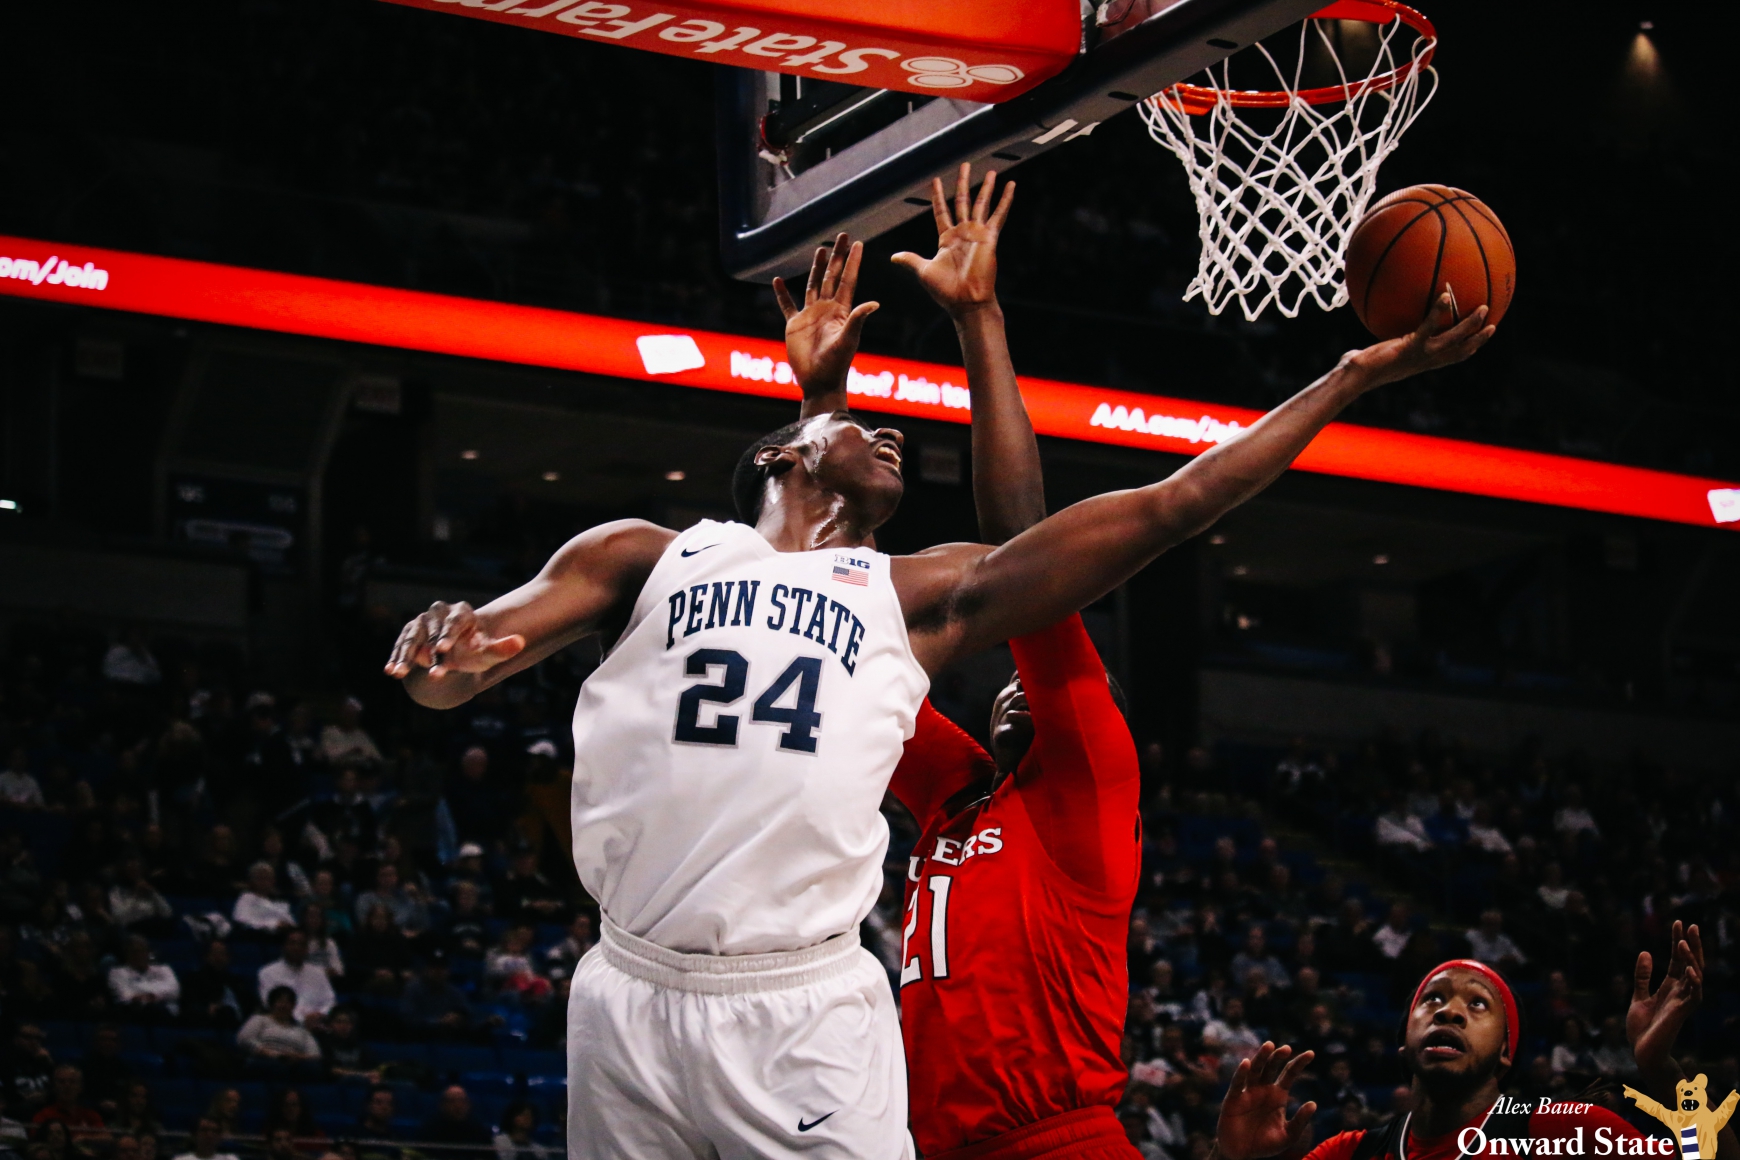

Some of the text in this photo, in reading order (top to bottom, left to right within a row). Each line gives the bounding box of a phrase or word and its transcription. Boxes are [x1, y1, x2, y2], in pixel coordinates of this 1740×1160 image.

[731, 351, 773, 381] Not
[666, 580, 866, 678] PENN STATE
[671, 648, 825, 757] 24
[900, 875, 953, 988] 21
